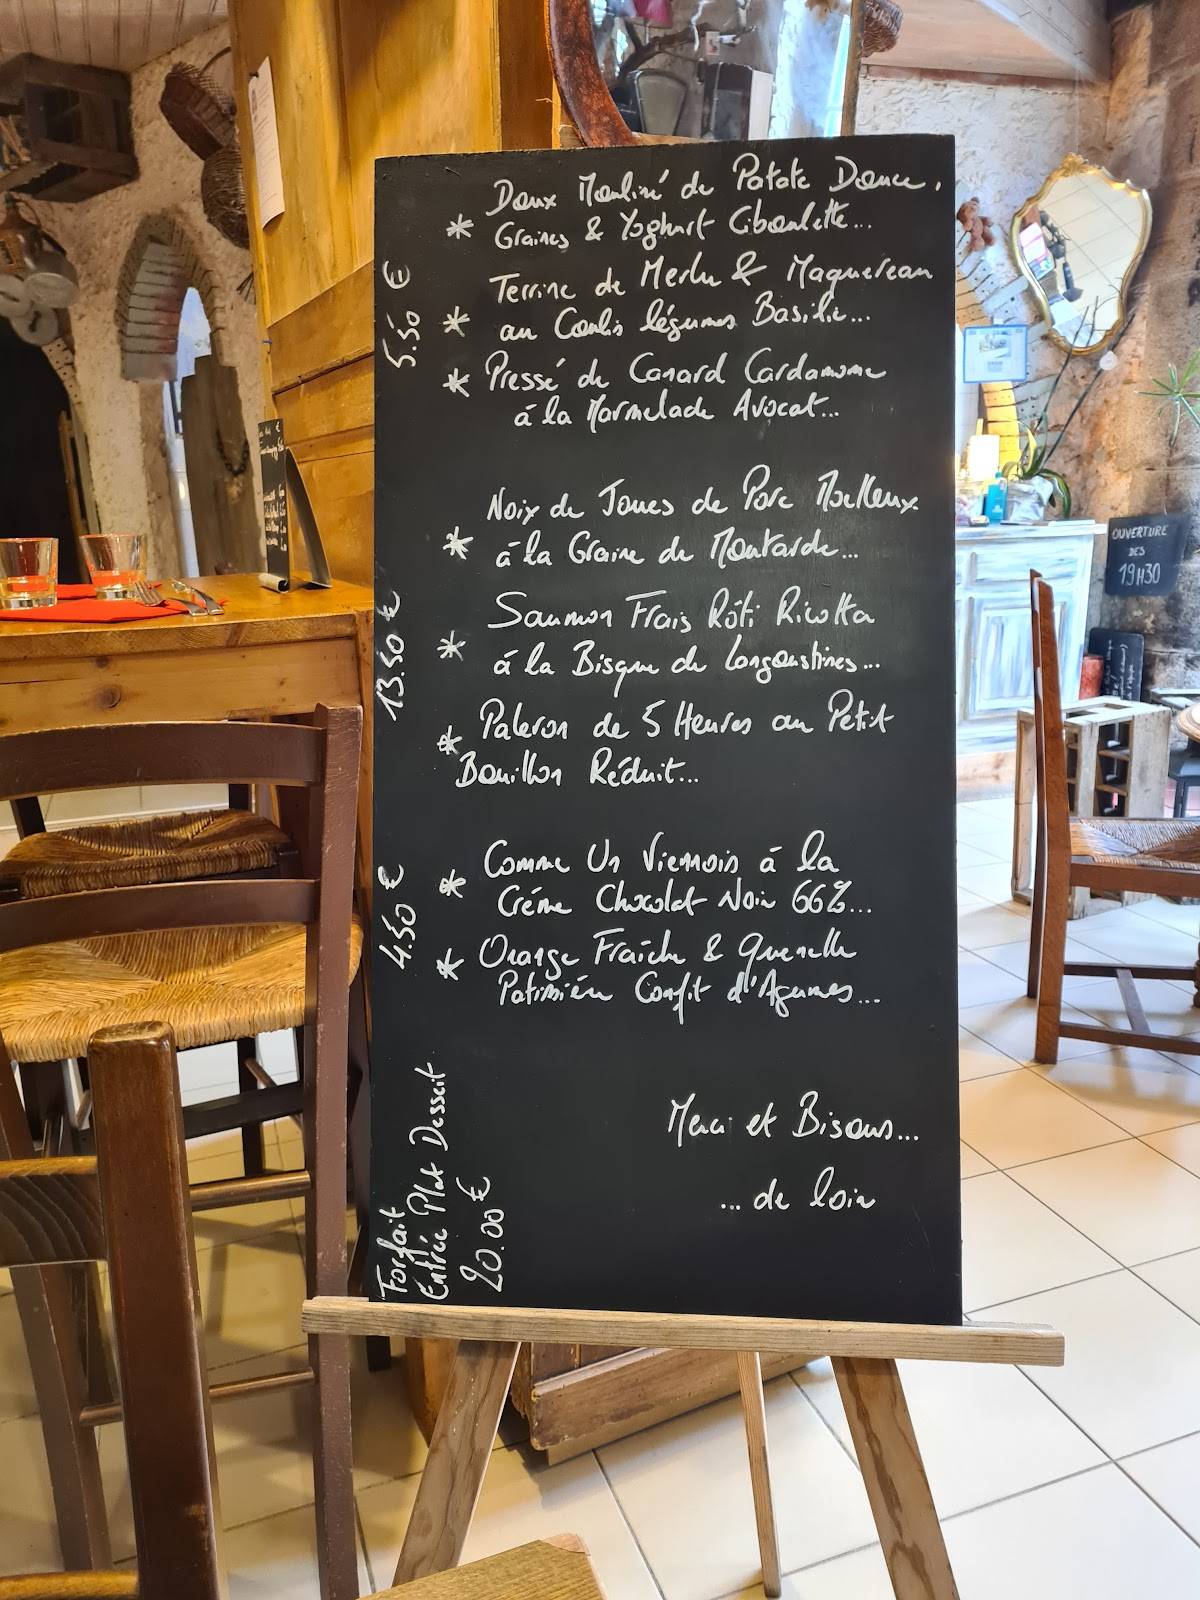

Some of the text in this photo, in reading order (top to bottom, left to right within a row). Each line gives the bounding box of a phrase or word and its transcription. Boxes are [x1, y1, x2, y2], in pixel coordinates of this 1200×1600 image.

[680, 170, 715, 200] de
[732, 152, 811, 191] Patate
[494, 220, 570, 250] Graines
[584, 215, 605, 242] &
[619, 207, 716, 251] Yoghurt
[382, 260, 411, 290] €
[488, 272, 577, 304] Terrine
[594, 266, 626, 297] de
[640, 250, 723, 290] Merlu
[730, 250, 768, 287] &
[499, 323, 539, 342] au
[484, 349, 567, 392] Pressé
[577, 357, 610, 389] de
[628, 351, 729, 385] Canard
[541, 394, 573, 426] la
[486, 486, 541, 526] Noix
[549, 492, 585, 519] de
[597, 478, 675, 517] Joues
[691, 486, 729, 516] de
[742, 463, 794, 512] Porc
[522, 529, 553, 567] la
[568, 530, 646, 565] Graine
[657, 535, 695, 565] de
[1112, 525, 1168, 540] OUVERTURE
[1119, 563, 1161, 586] 19H30
[376, 590, 401, 622] €
[487, 585, 876, 634] Saumon Frais Rôti Ricotta
[523, 641, 556, 676] la
[571, 639, 660, 699] Bisque
[670, 644, 708, 674] de
[479, 688, 895, 741] Paleron de 5 Heures au Petit
[483, 839, 571, 879] Comme
[796, 829, 840, 873] la
[377, 863, 417, 970] 4.50 €
[478, 933, 581, 982] Orange
[702, 932, 724, 963] &
[667, 1092, 732, 1148] Merci
[745, 1101, 778, 1139] et
[405, 1161, 447, 1216] Plat
[809, 1166, 877, 1211] loin
[377, 1206, 427, 1300] Forfait
[455, 1176, 505, 1293] 20.00 €
